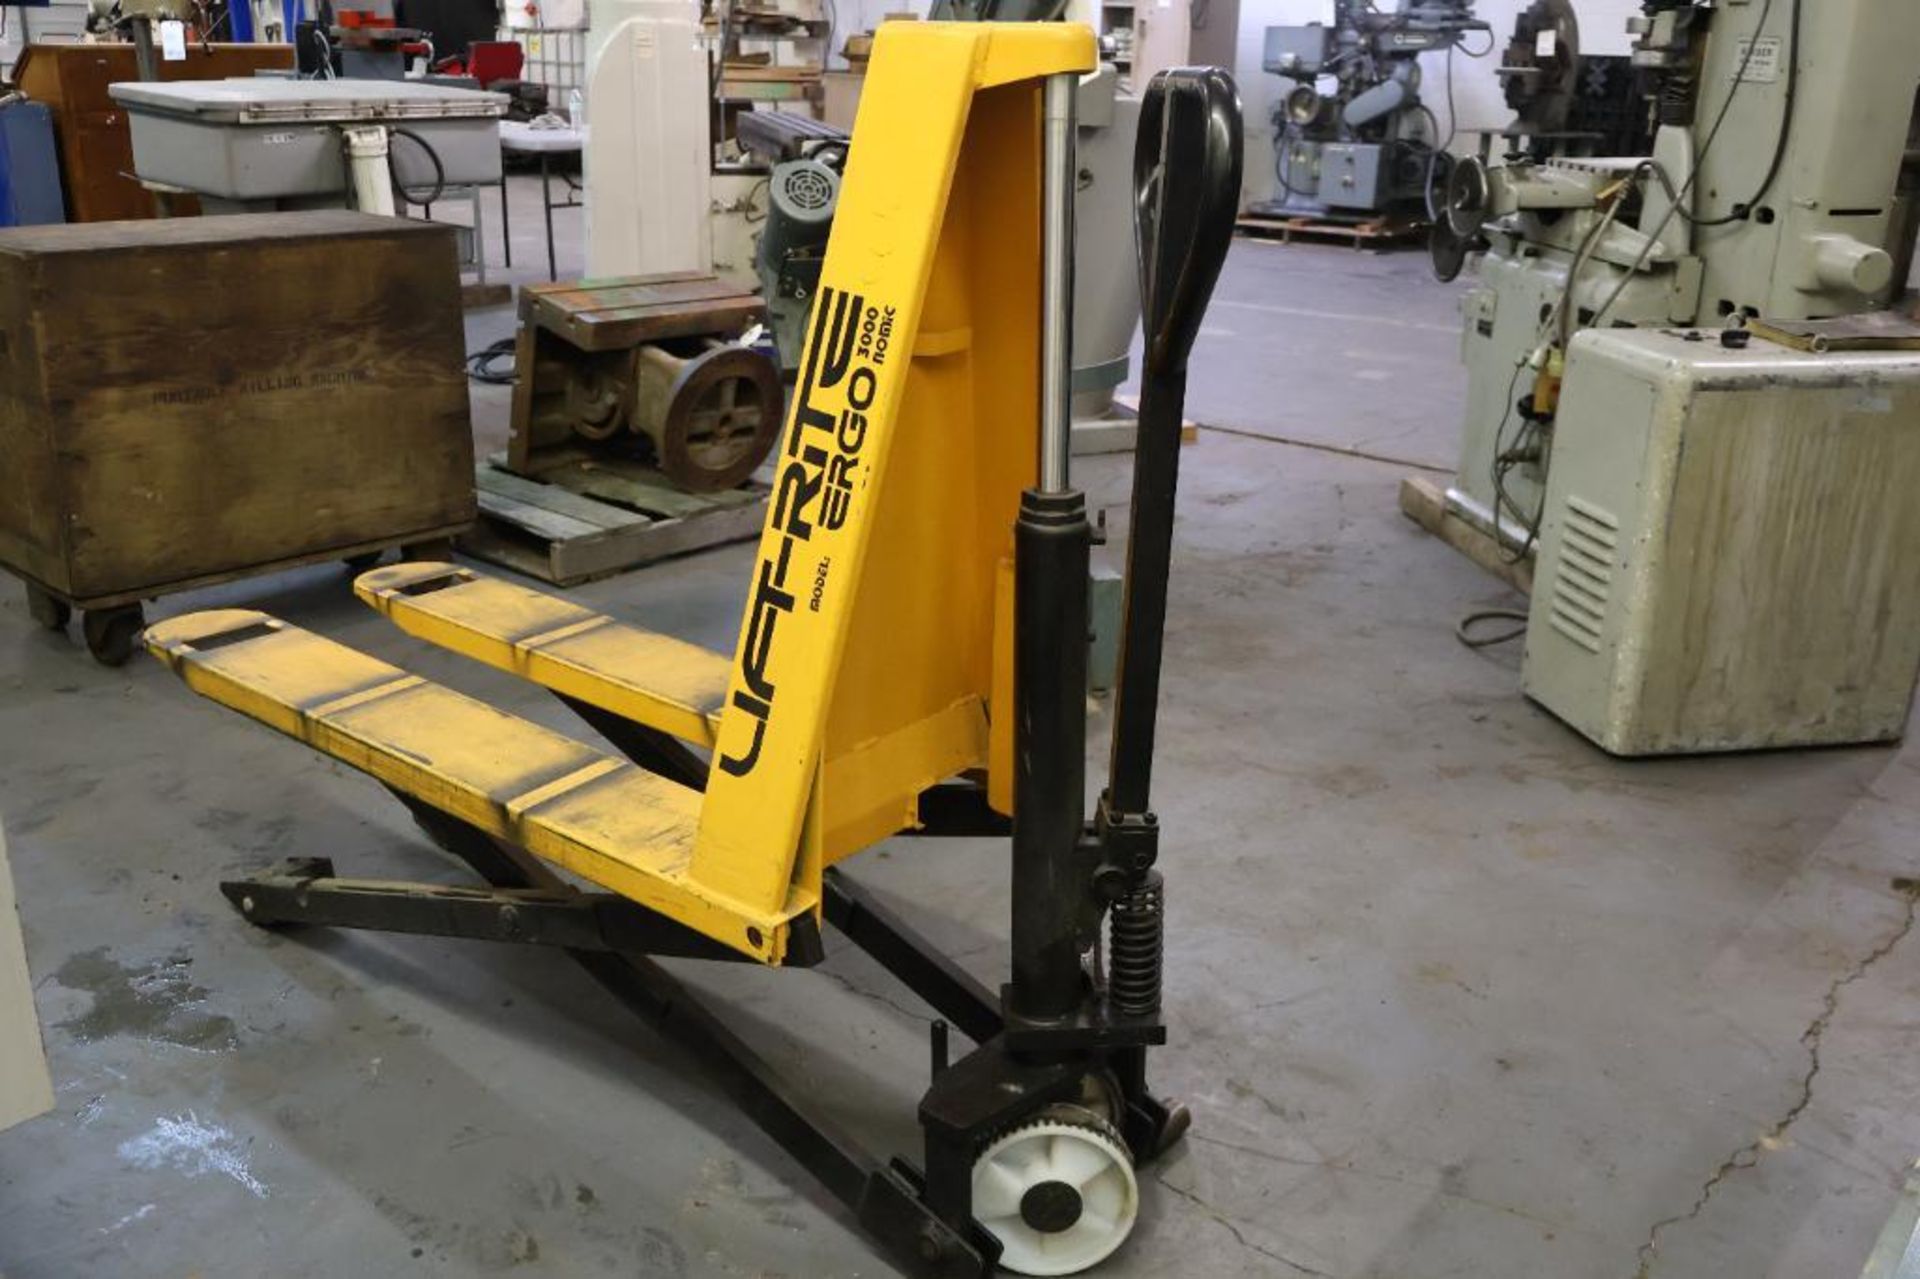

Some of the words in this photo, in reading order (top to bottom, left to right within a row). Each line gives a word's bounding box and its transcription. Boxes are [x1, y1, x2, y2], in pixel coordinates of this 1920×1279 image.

[856, 306, 879, 359] 3000
[818, 366, 876, 532] ERGO
[809, 556, 832, 613] MODEL:
